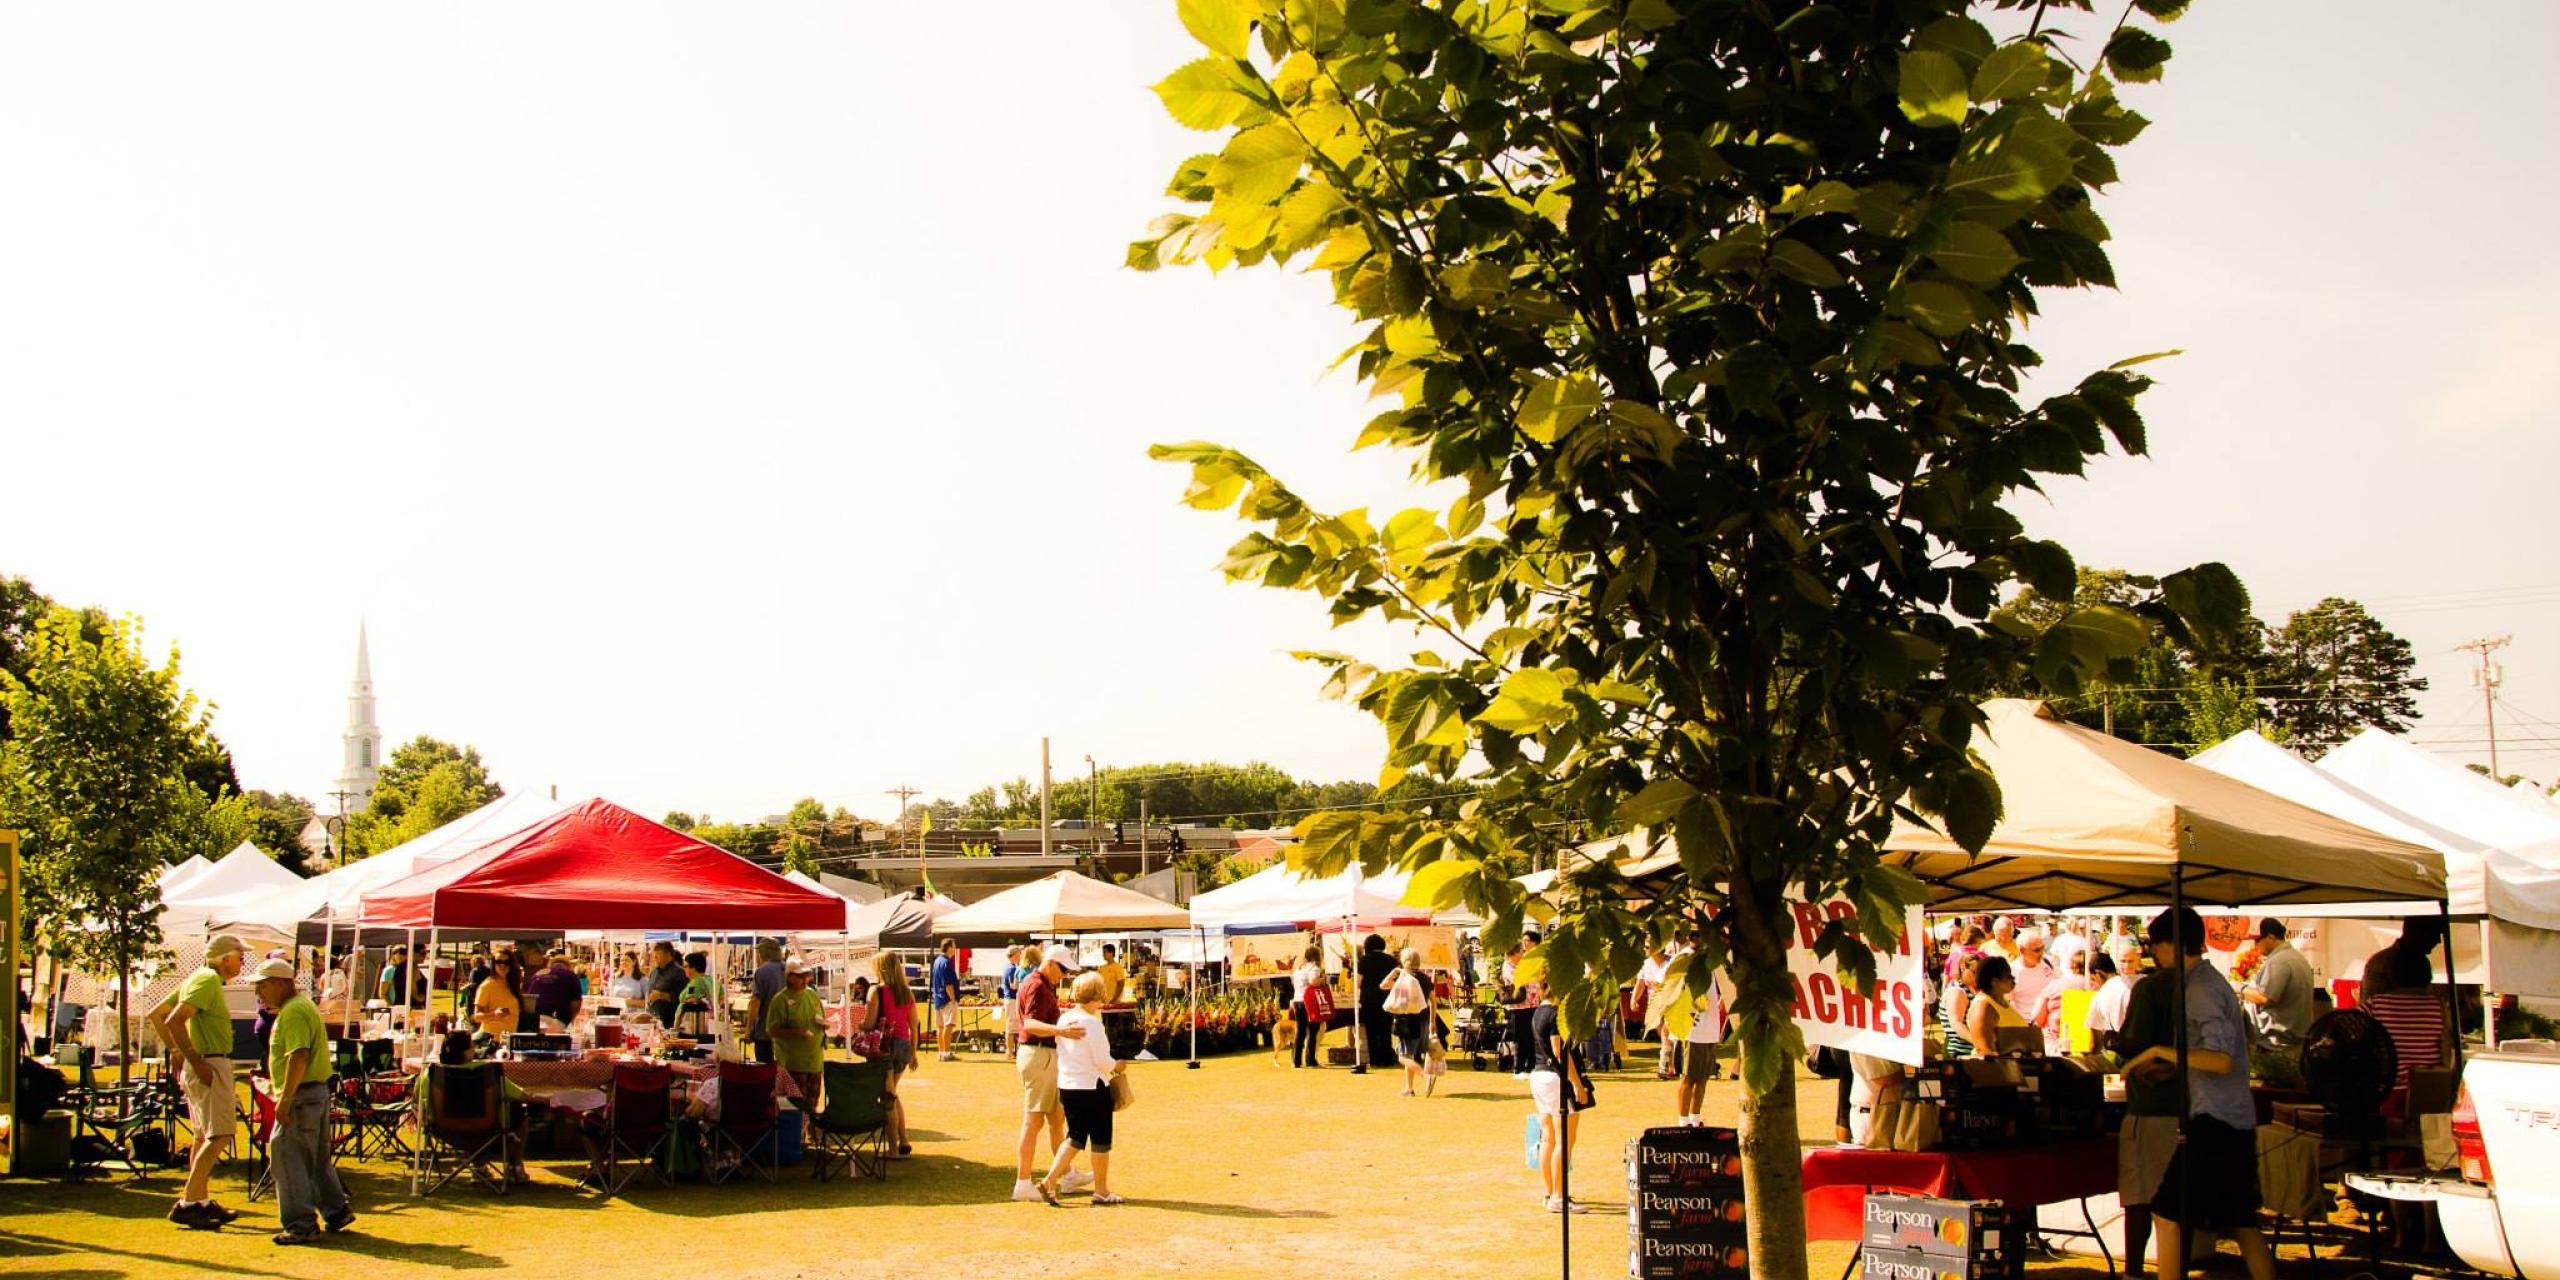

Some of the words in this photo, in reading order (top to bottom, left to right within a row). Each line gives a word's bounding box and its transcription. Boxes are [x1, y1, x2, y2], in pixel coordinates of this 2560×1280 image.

[1785, 971, 1912, 1038] ACHES
[1643, 1146, 1710, 1165] Pearson
[1643, 1192, 1712, 1210] Pearson
[1865, 1202, 1932, 1228] Pearson
[1645, 1238, 1714, 1257] Pearson
[1864, 1252, 1931, 1280] Pearson
